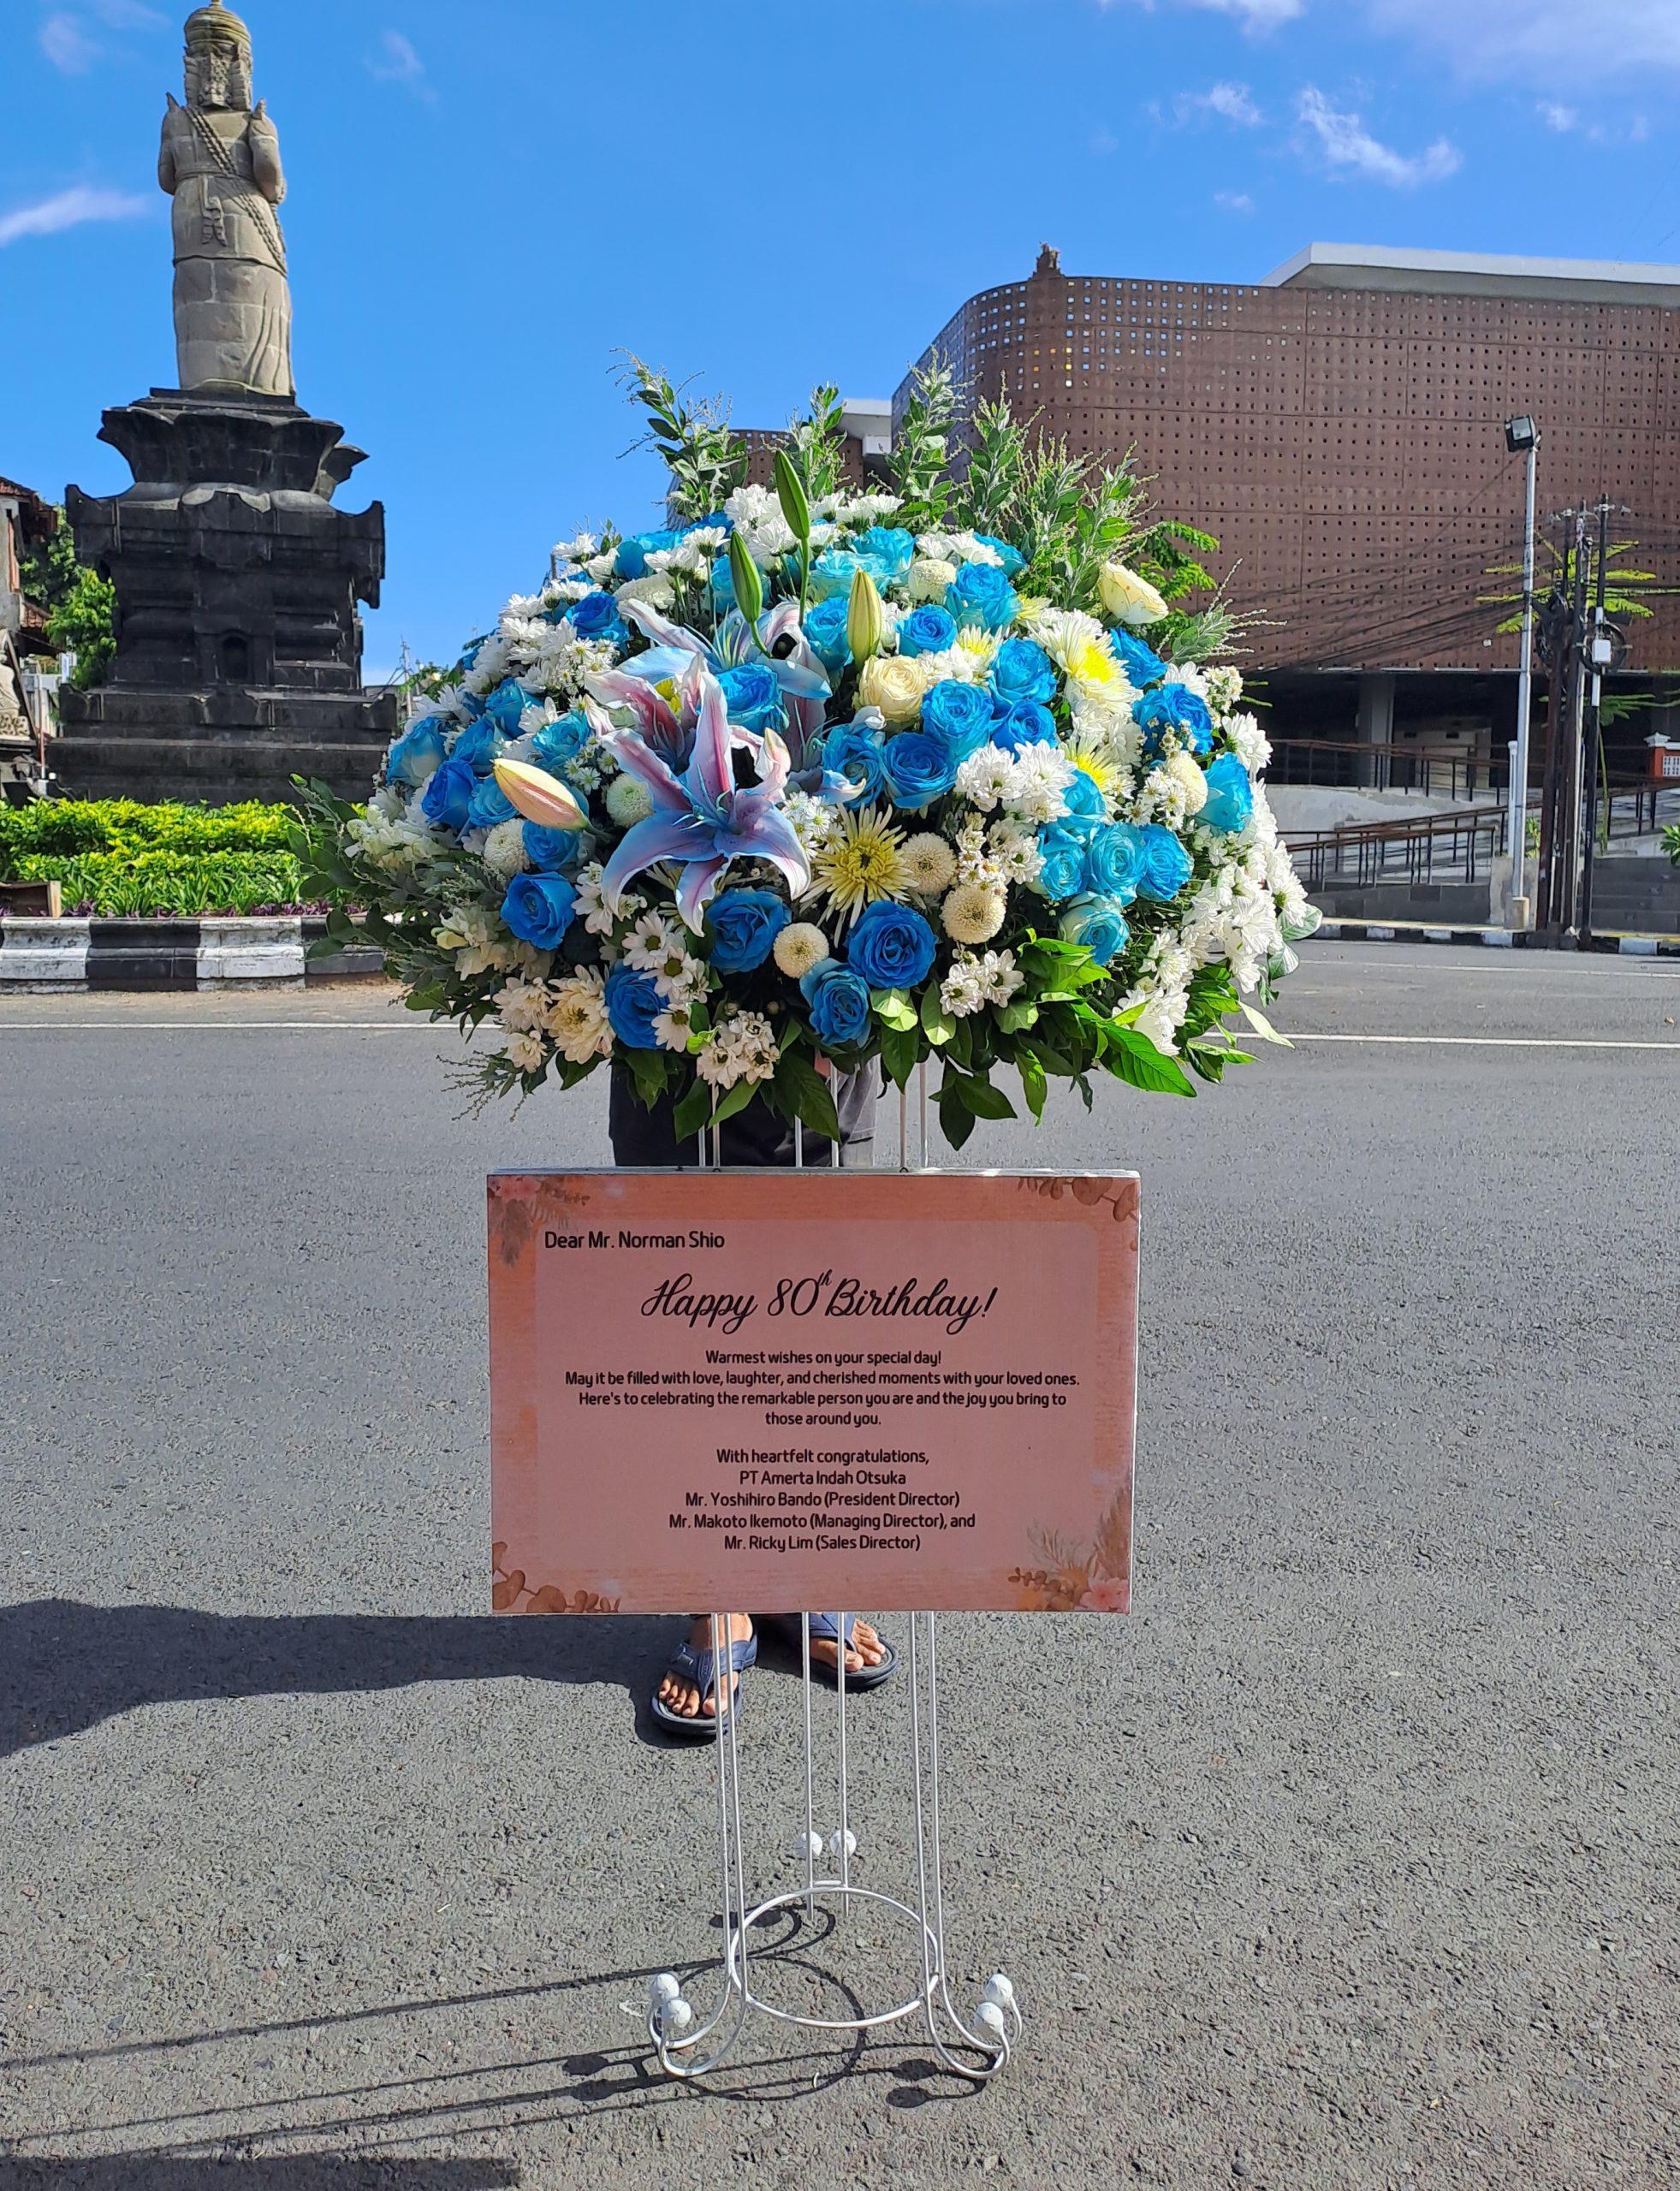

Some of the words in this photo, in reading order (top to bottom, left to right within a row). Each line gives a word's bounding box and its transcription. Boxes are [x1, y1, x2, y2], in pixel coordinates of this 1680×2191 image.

[544, 1231, 585, 1249] Dear
[588, 1230, 615, 1249] Mr.
[618, 1230, 686, 1249] Norman
[688, 1230, 726, 1249] Shio
[640, 1272, 758, 1336] Happy
[824, 1277, 1000, 1336] Birthday!
[705, 1350, 766, 1364] Warmest
[767, 1350, 814, 1364] wishes
[815, 1353, 833, 1364] on
[834, 1353, 865, 1368] your
[866, 1350, 912, 1367] special
[913, 1350, 941, 1368] day!
[565, 1370, 594, 1389] May
[595, 1371, 606, 1386] it
[607, 1371, 625, 1386] be
[626, 1370, 660, 1385] filled
[661, 1369, 691, 1385] with
[692, 1370, 724, 1386] love,
[726, 1370, 785, 1388] laughter,
[786, 1369, 811, 1385] and
[812, 1369, 876, 1385] cherished
[878, 1371, 941, 1385] moments
[942, 1370, 972, 1385] with
[974, 1374, 1005, 1388] your
[1006, 1370, 1042, 1386] loved
[1044, 1375, 1080, 1386] ones.
[579, 1391, 621, 1406] Here's
[623, 1392, 639, 1405] to
[640, 1391, 715, 1408] celebrating
[716, 1391, 739, 1405] the
[741, 1390, 816, 1405] remarkable
[817, 1393, 864, 1408] person
[865, 1394, 891, 1408] you
[892, 1394, 914, 1405] are
[916, 1390, 941, 1405] and
[941, 1391, 965, 1405] the
[964, 1391, 987, 1409] joy
[988, 1394, 1014, 1409] you
[1016, 1391, 1049, 1409] bring
[1051, 1392, 1067, 1406] to
[764, 1410, 804, 1426] those
[805, 1410, 852, 1426] around
[853, 1414, 882, 1428] you.
[716, 1448, 750, 1464] With
[751, 1448, 815, 1464] heartfelt
[816, 1448, 929, 1467] congratulations,
[739, 1470, 759, 1485] PT
[760, 1470, 814, 1486] Amerta
[816, 1470, 854, 1485] Indah
[855, 1470, 906, 1485] Otsuka
[685, 1492, 708, 1507] Mr.
[709, 1491, 776, 1507] Yoshihiro
[777, 1491, 822, 1507] Bando
[823, 1491, 897, 1509] (President
[898, 1491, 960, 1509] Director)
[668, 1513, 692, 1529] Mr.
[693, 1513, 748, 1529] Makoto
[750, 1513, 808, 1529] Ikemoto
[809, 1512, 881, 1531] (Managing
[882, 1512, 948, 1530] Director),
[950, 1512, 976, 1528] and
[724, 1535, 746, 1550] Mr.
[749, 1535, 787, 1553] Ricky
[788, 1535, 814, 1550] Lim
[815, 1534, 858, 1552] (Sales
[859, 1534, 921, 1552] Director)
